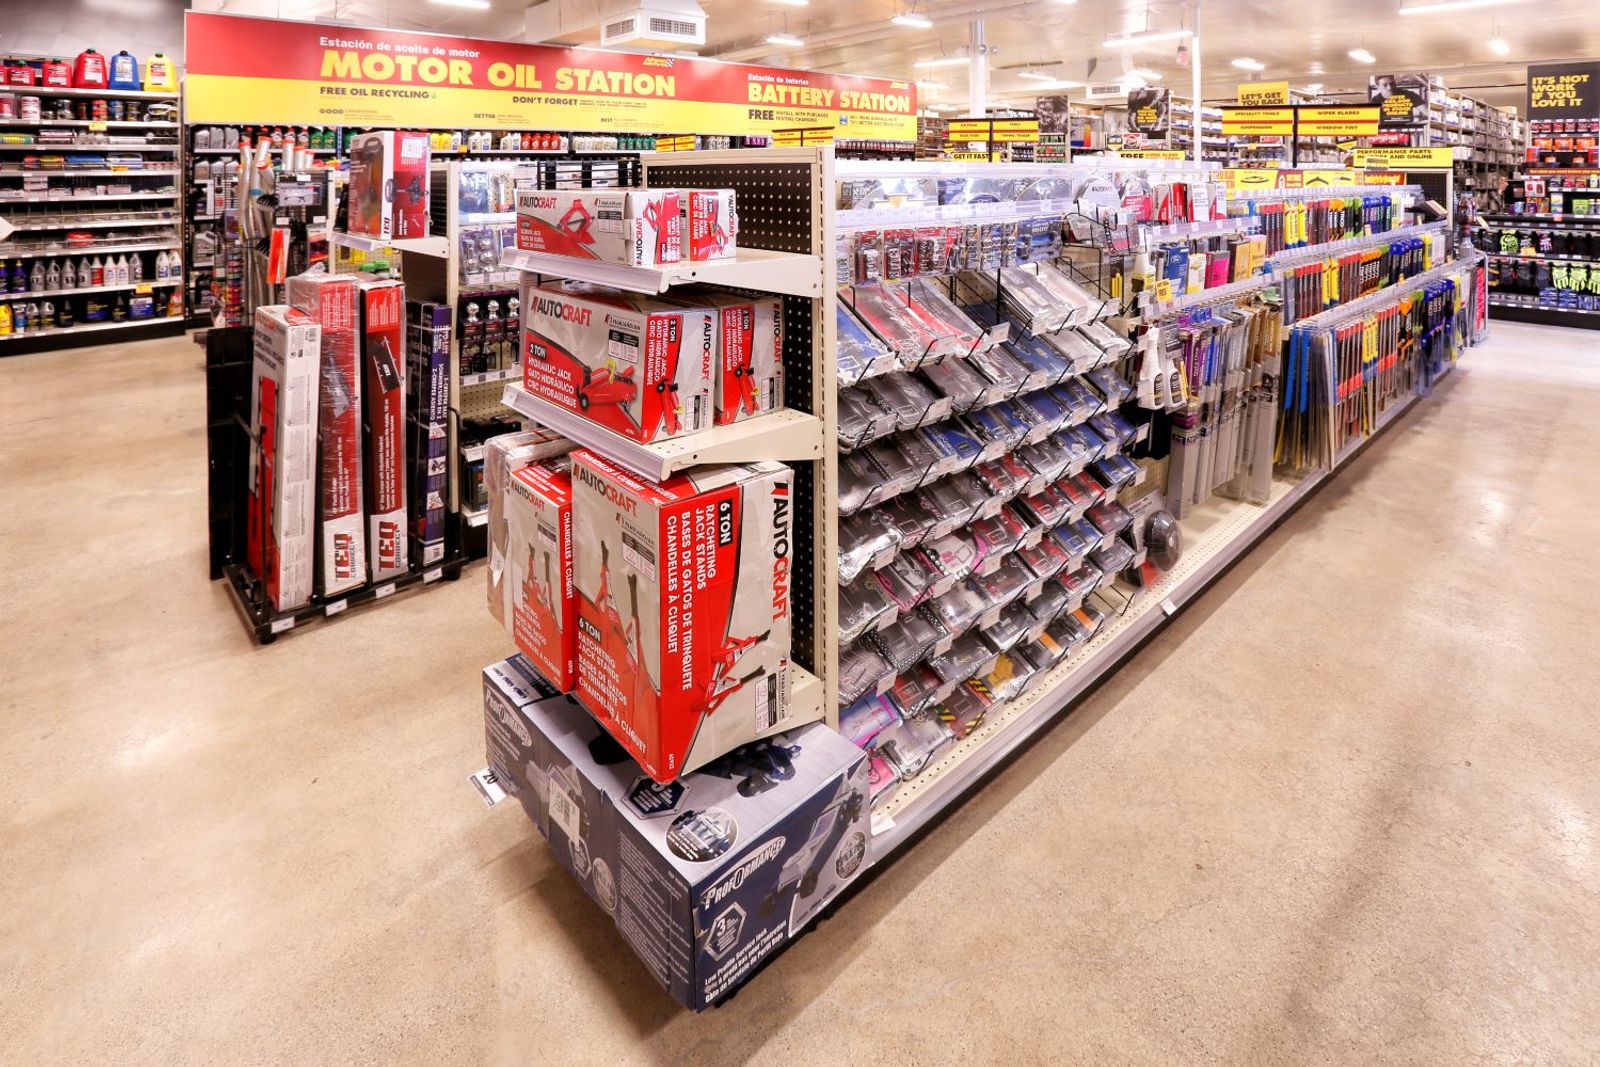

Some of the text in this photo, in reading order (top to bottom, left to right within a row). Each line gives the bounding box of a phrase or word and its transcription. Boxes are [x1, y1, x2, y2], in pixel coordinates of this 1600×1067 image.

[320, 37, 480, 58] Estación de aceite de motor
[320, 50, 676, 96] MOTOR OIL STATION
[748, 74, 775, 82] Estación
[1560, 75, 1589, 83] NOT
[320, 86, 430, 98] FREE OIL RECYCLING
[512, 96, 578, 106] DON'T FORGET
[748, 82, 910, 112] BATTERY STATION
[1548, 91, 1576, 99] YOU
[748, 109, 774, 120] FREE
[523, 196, 557, 208] AUTOCRAFT
[537, 298, 592, 327] AUTOCRAFT
[534, 345, 546, 359] TON
[703, 323, 712, 380] AUTOCRAFT
[528, 357, 572, 381] HYDRAULIC JACK
[528, 368, 541, 379] GATO
[528, 379, 577, 408] CRIC HYDRAULIQUE
[514, 483, 545, 511] AUTOCRAFT
[580, 467, 637, 517] AUTOCRAFT
[564, 512, 572, 560] CHANDELLES
[720, 502, 730, 544] 6 TON
[334, 534, 352, 582] TEQ
[379, 521, 398, 572] TEQ
[696, 508, 707, 590] JACK STANDS
[705, 504, 716, 579] RATCHETING
[772, 499, 789, 624] AUTOCRAFT
[667, 516, 679, 654] CHANDELLES À CLIQUET
[682, 511, 693, 691] BASES DE GATOS DE TRINQUETE
[579, 617, 601, 640] 6 TON
[578, 632, 616, 668] RATCHETING
[578, 644, 596, 662] JACK
[597, 656, 620, 683] STANDS
[578, 663, 587, 676] DE
[579, 655, 597, 676] BASES
[598, 671, 607, 685] DE
[607, 680, 628, 706] GATOS
[579, 677, 615, 718] CHANDELLES
[621, 719, 648, 754] CLIQUET
[702, 839, 785, 910] PROFORMANCE
[717, 918, 726, 937] 3
[705, 973, 717, 985] Low
[717, 957, 736, 976] Profile
[736, 939, 756, 960] Service
[706, 932, 784, 1003] Gato de Servicio de Perfil Bajo
[738, 955, 748, 966] bas
[748, 944, 760, 960] pour
